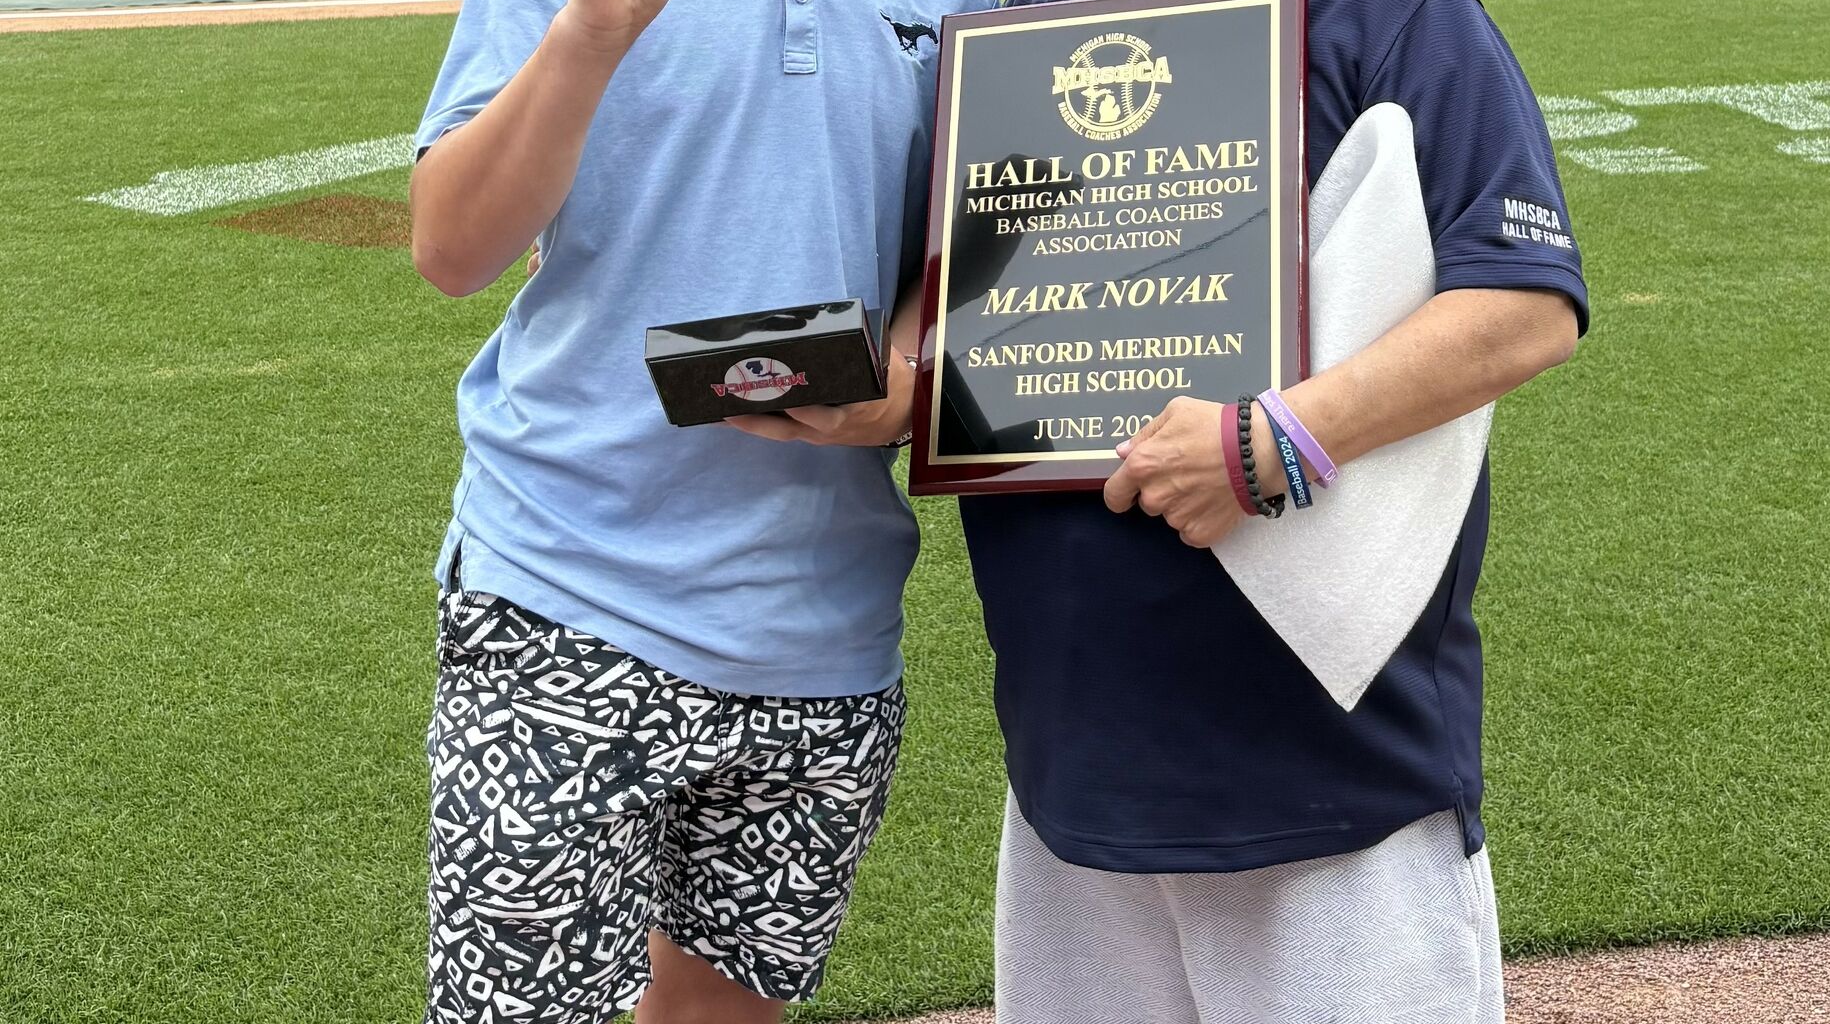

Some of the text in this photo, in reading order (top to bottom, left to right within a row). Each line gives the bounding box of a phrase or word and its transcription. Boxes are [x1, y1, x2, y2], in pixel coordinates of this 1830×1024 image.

[1069, 32, 1152, 62] MICHIGAN HIGH SCHOOL
[1052, 56, 1172, 94] MHSBCA
[1058, 93, 1162, 141] BASEBALL COACHES ASSOCIATION
[966, 139, 1260, 189] HALL OF FAME
[966, 175, 1258, 214] MICHIGAN HIGH SCHOOL
[996, 201, 1224, 235] BASEBALL COACHES
[1504, 198, 1561, 230] MHSBCA
[1032, 229, 1182, 256] ASSOCIATION
[1502, 221, 1573, 249] HALL OF FAME
[980, 273, 1234, 315] MARK NOVAK
[968, 333, 1244, 368] SANFORD MERIDIAN
[1015, 367, 1192, 396] HIGH SCHOOL
[1033, 414, 1153, 441] JUNE 202
[1275, 407, 1295, 433] There
[1279, 436, 1308, 506] Baseball 2024
